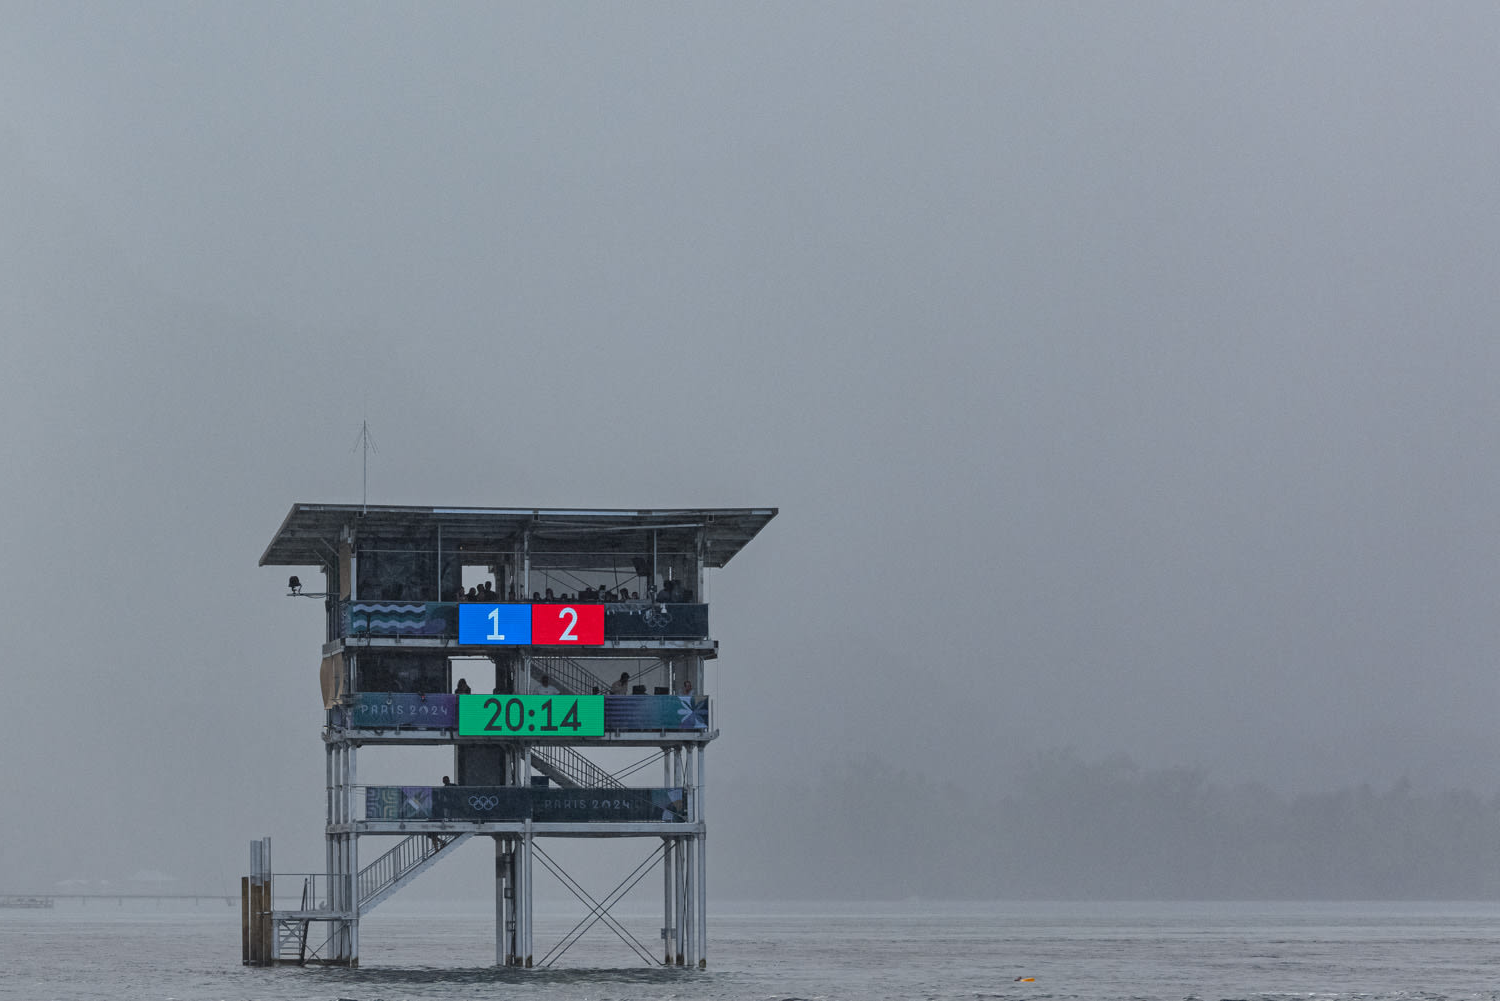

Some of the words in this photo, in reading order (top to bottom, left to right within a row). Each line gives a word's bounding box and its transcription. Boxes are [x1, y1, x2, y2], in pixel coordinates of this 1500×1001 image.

[486, 607, 505, 641] 1
[558, 607, 578, 641] 2
[361, 704, 404, 715] PARIS
[410, 705, 448, 716] 2024
[483, 697, 582, 732] 20:14
[544, 799, 587, 809] PARIS
[592, 799, 630, 809] 2024
